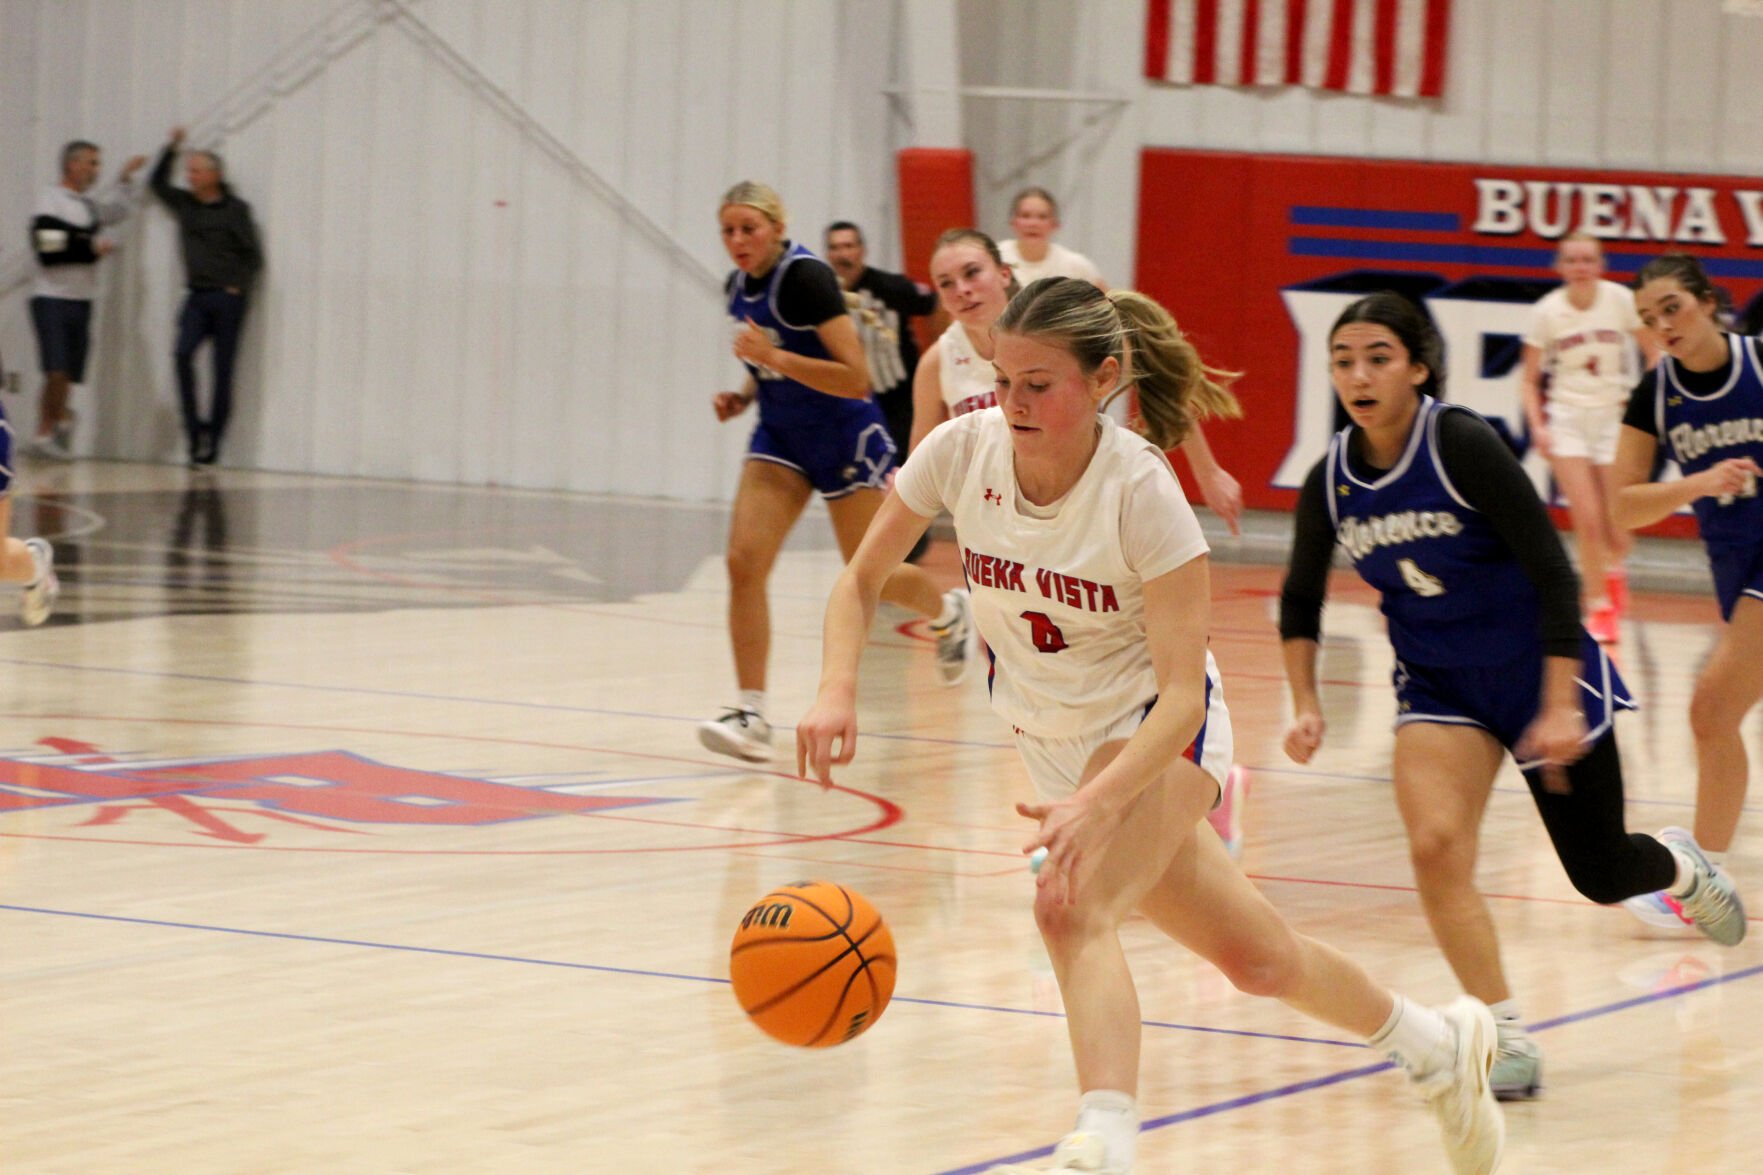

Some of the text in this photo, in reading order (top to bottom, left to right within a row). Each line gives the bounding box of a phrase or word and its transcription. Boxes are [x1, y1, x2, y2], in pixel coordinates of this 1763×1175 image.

[1472, 178, 1728, 245] BUENA
[1035, 567, 1120, 613] VISTA
[1396, 557, 1447, 597] 4
